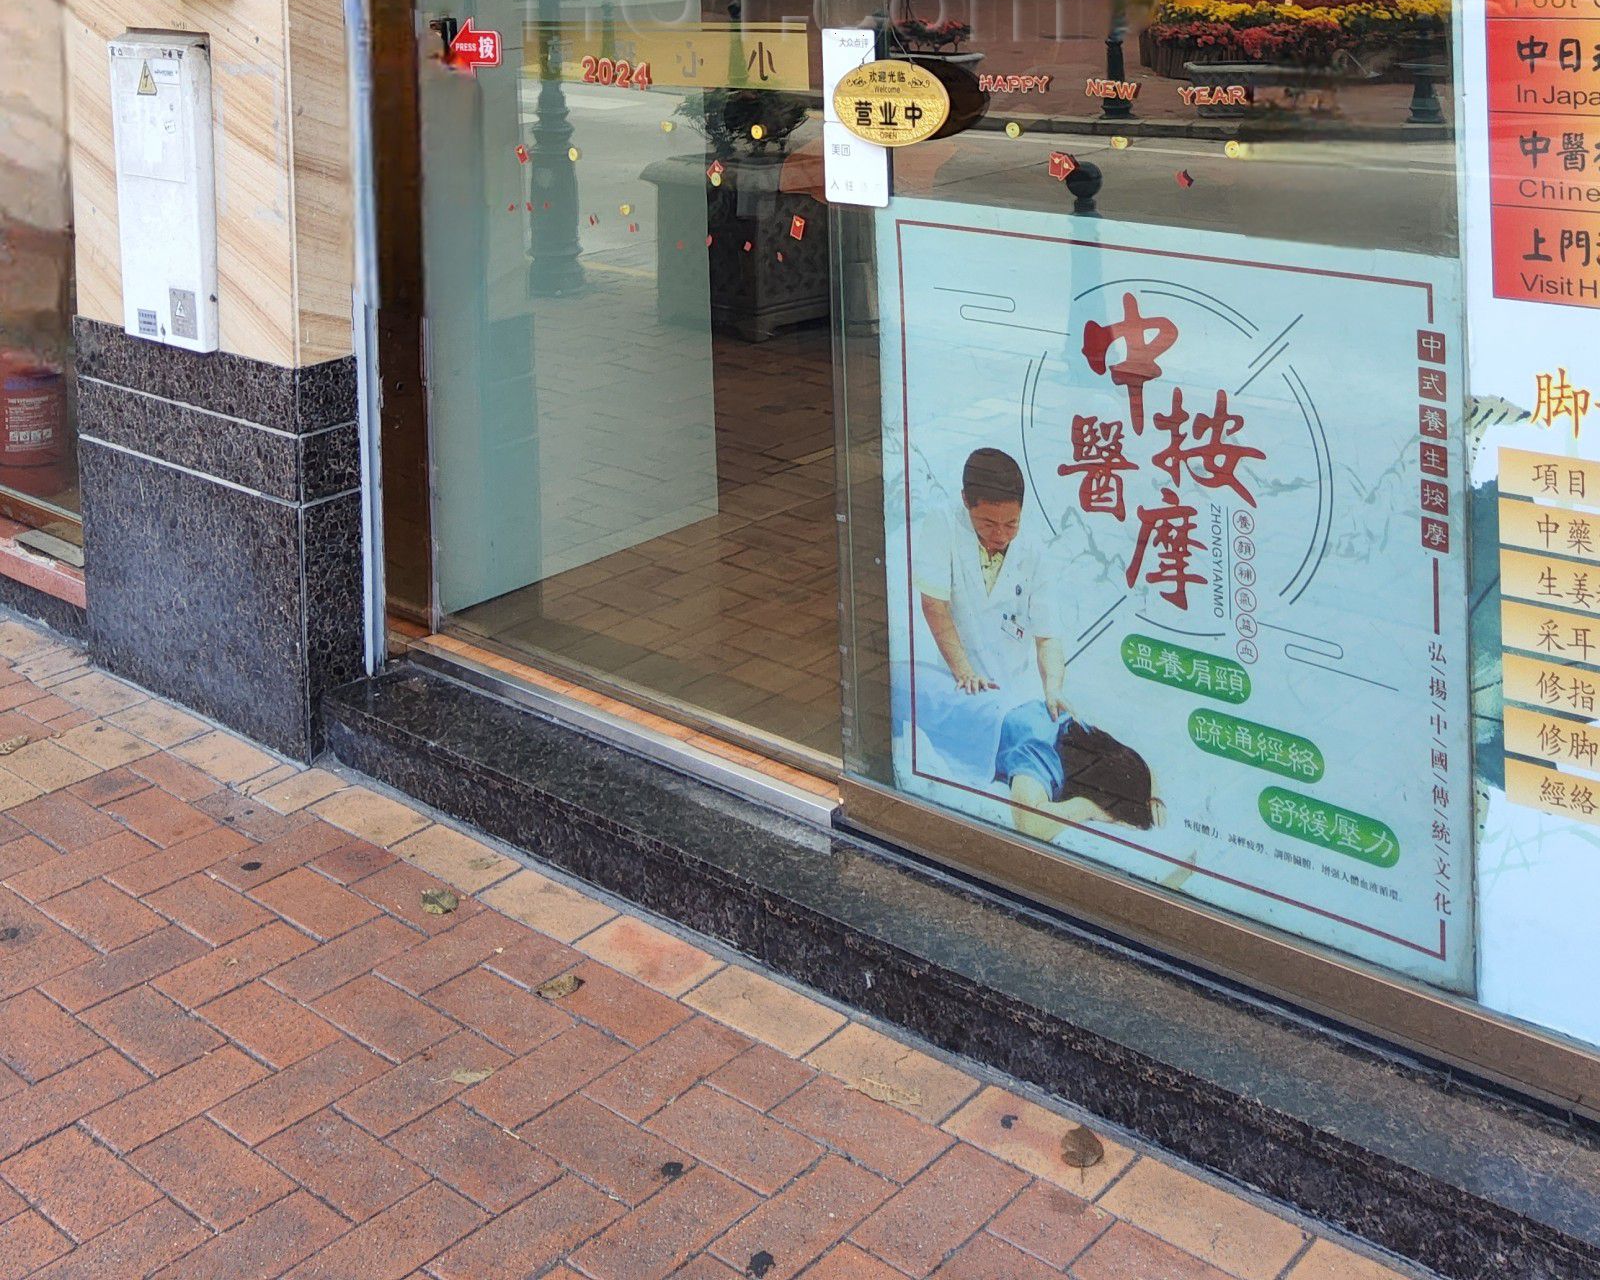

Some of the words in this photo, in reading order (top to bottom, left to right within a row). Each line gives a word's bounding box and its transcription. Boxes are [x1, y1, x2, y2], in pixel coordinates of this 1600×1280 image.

[455, 42, 477, 52] PRESS
[1516, 34, 1600, 75] 中日
[581, 54, 653, 93] 2024
[868, 70, 906, 84] 欢迎光临
[978, 73, 1051, 95] HAPPY
[1085, 77, 1140, 101] NEW
[1177, 85, 1247, 106] YEAR
[1517, 84, 1537, 103] In
[854, 100, 923, 129] 营业中
[879, 131, 898, 139] OPEN
[1522, 227, 1600, 267] 上門
[1520, 272, 1574, 296] Visit
[1531, 463, 1585, 498] 項目
[1210, 503, 1225, 619] ZHONGYIANMO
[1536, 619, 1596, 662] 采耳
[1536, 671, 1596, 713] 修指
[1267, 795, 1394, 858] 舒緩壓力
